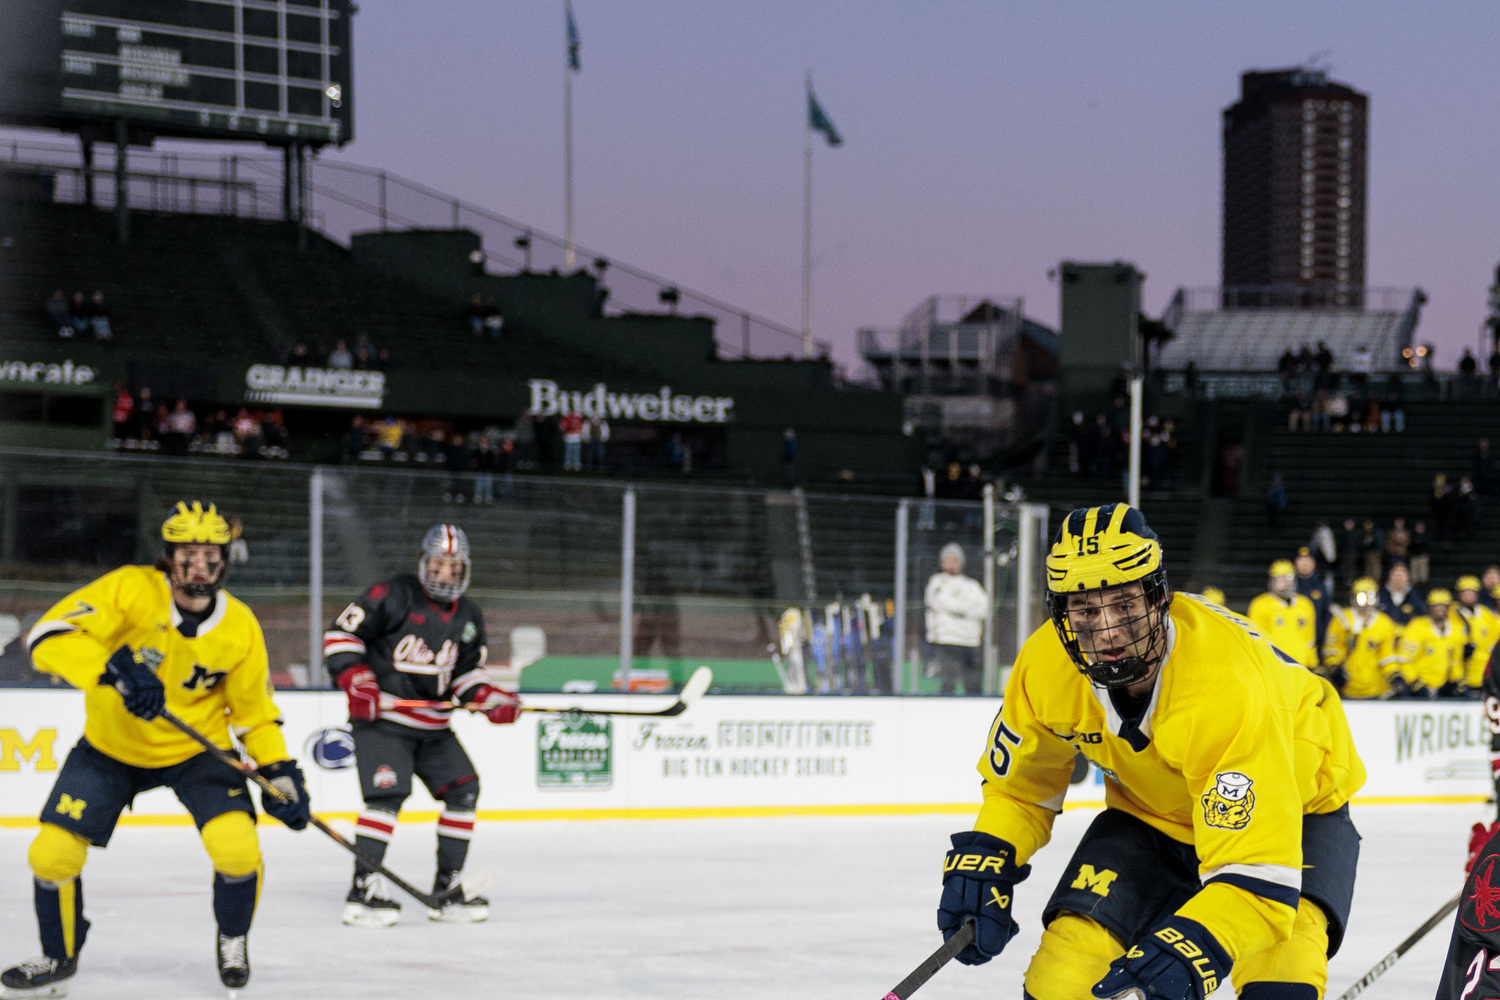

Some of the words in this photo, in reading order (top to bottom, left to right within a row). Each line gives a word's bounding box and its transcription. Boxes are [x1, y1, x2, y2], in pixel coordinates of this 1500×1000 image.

[246, 363, 386, 392] GRAINGER
[528, 378, 735, 423] Budweiser
[1077, 535, 1099, 557] 15
[62, 601, 95, 621] 7
[180, 663, 229, 693] M
[0, 729, 58, 771] M
[632, 722, 709, 750] Frozen
[720, 723, 874, 747] CONFINES
[663, 757, 689, 777] BIG
[695, 757, 723, 777] TEN
[730, 756, 790, 777] HOCKEY
[796, 756, 848, 776] SERIES
[1221, 785, 1240, 798] M
[55, 792, 87, 820] M
[1071, 864, 1118, 898] M
